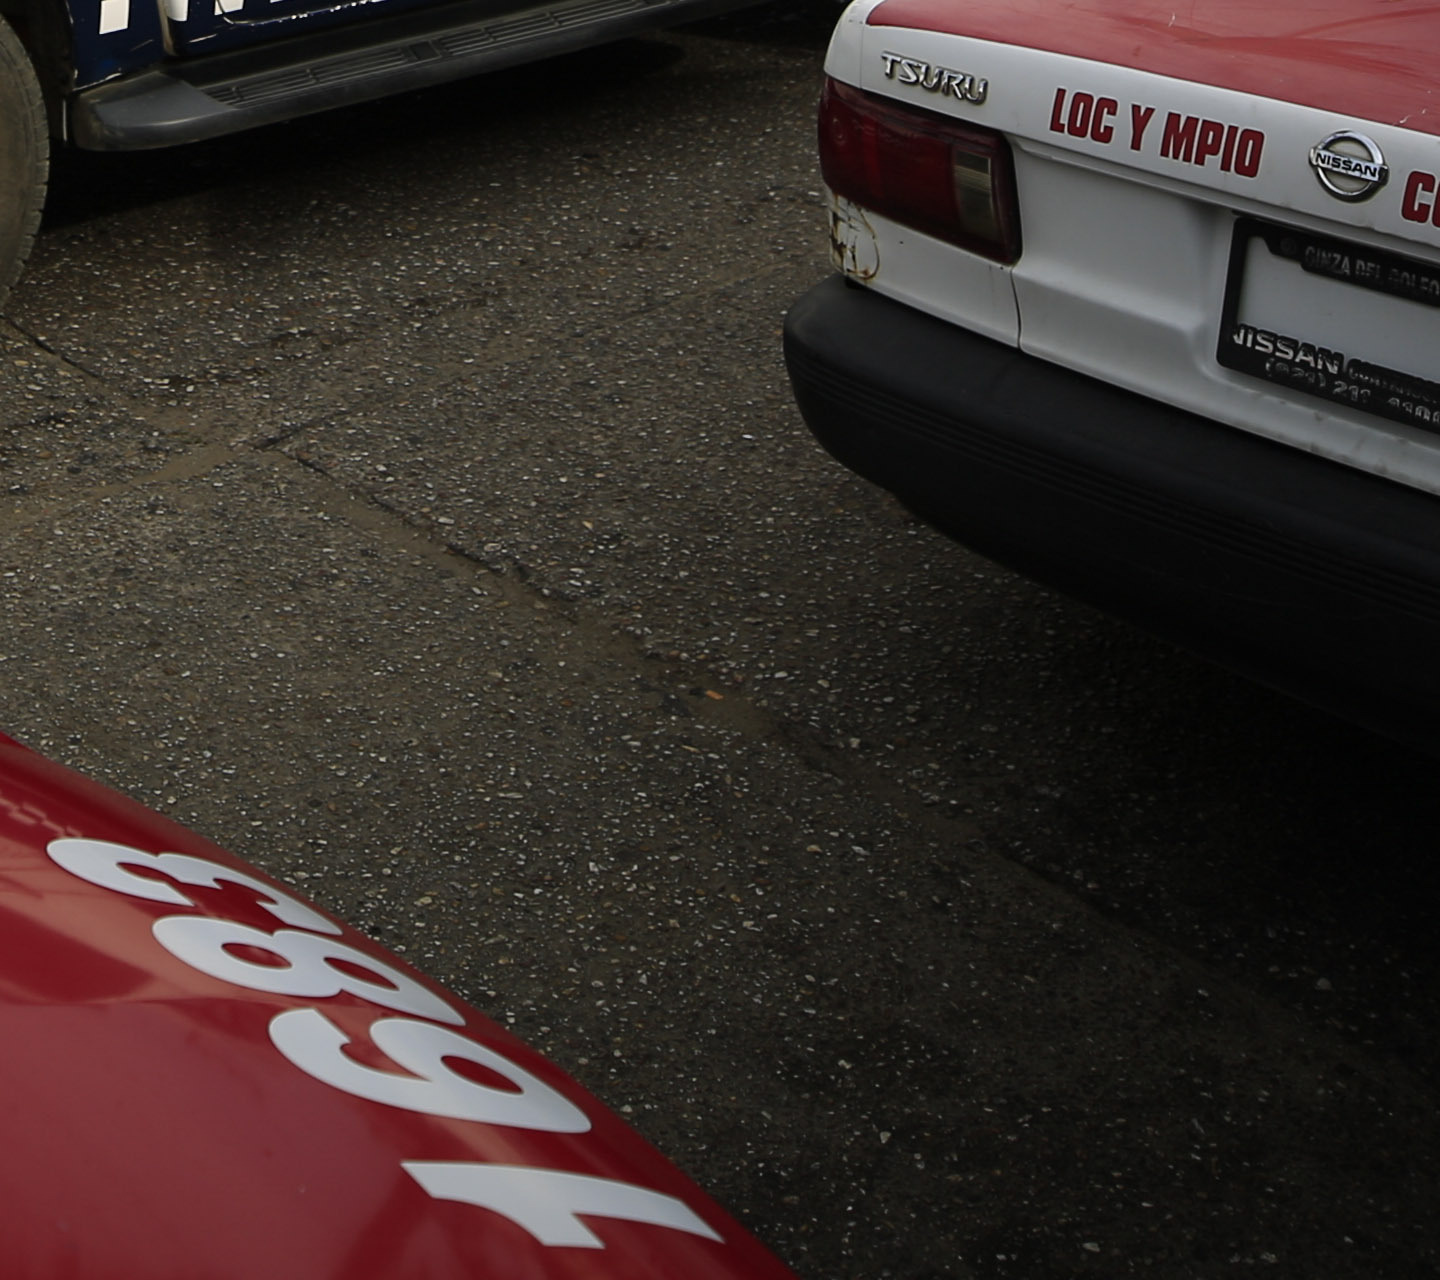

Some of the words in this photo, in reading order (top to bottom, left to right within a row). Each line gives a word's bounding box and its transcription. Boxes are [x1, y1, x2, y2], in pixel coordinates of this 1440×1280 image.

[880, 50, 989, 105] TSURU
[1050, 87, 1118, 144] LOC
[1129, 104, 1155, 152] Y
[1159, 110, 1266, 179] MPIO
[1315, 152, 1378, 178] NISSAN
[46, 836, 725, 1250] 1683
